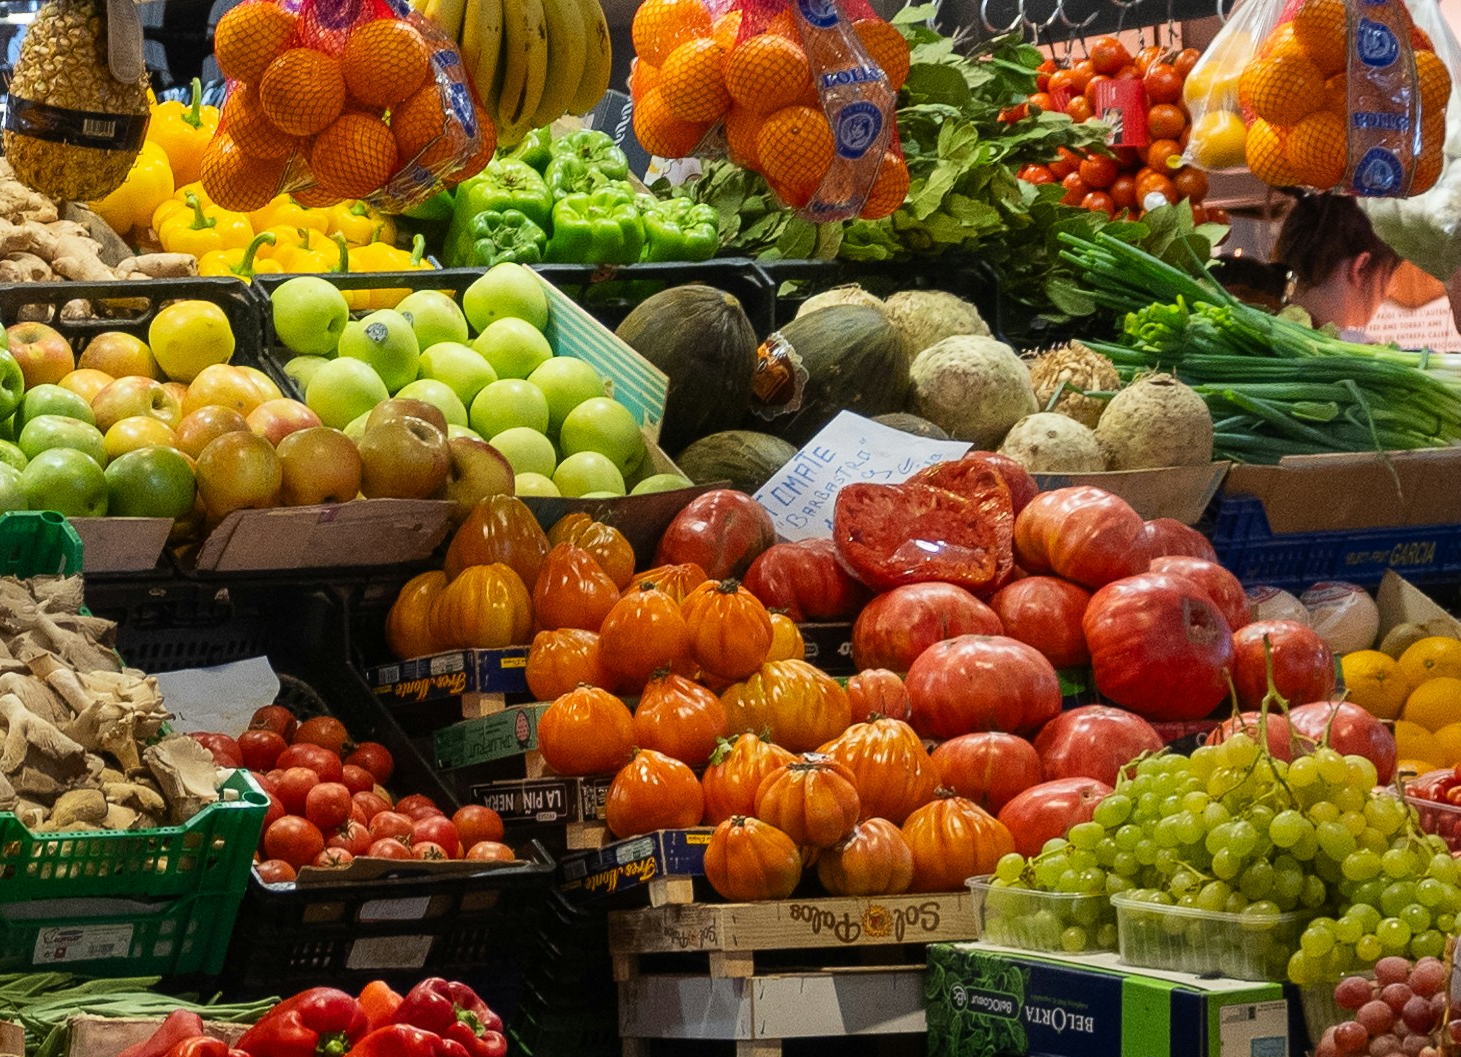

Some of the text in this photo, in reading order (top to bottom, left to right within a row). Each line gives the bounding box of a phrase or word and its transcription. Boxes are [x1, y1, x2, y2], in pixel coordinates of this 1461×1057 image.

[754, 446, 837, 517] TOMATE
[1390, 541, 1437, 566] GARCIA
[545, 790, 561, 808] LA
[790, 901, 940, 943] Sol Palos
[1026, 1005, 1094, 1033] BELORTA
